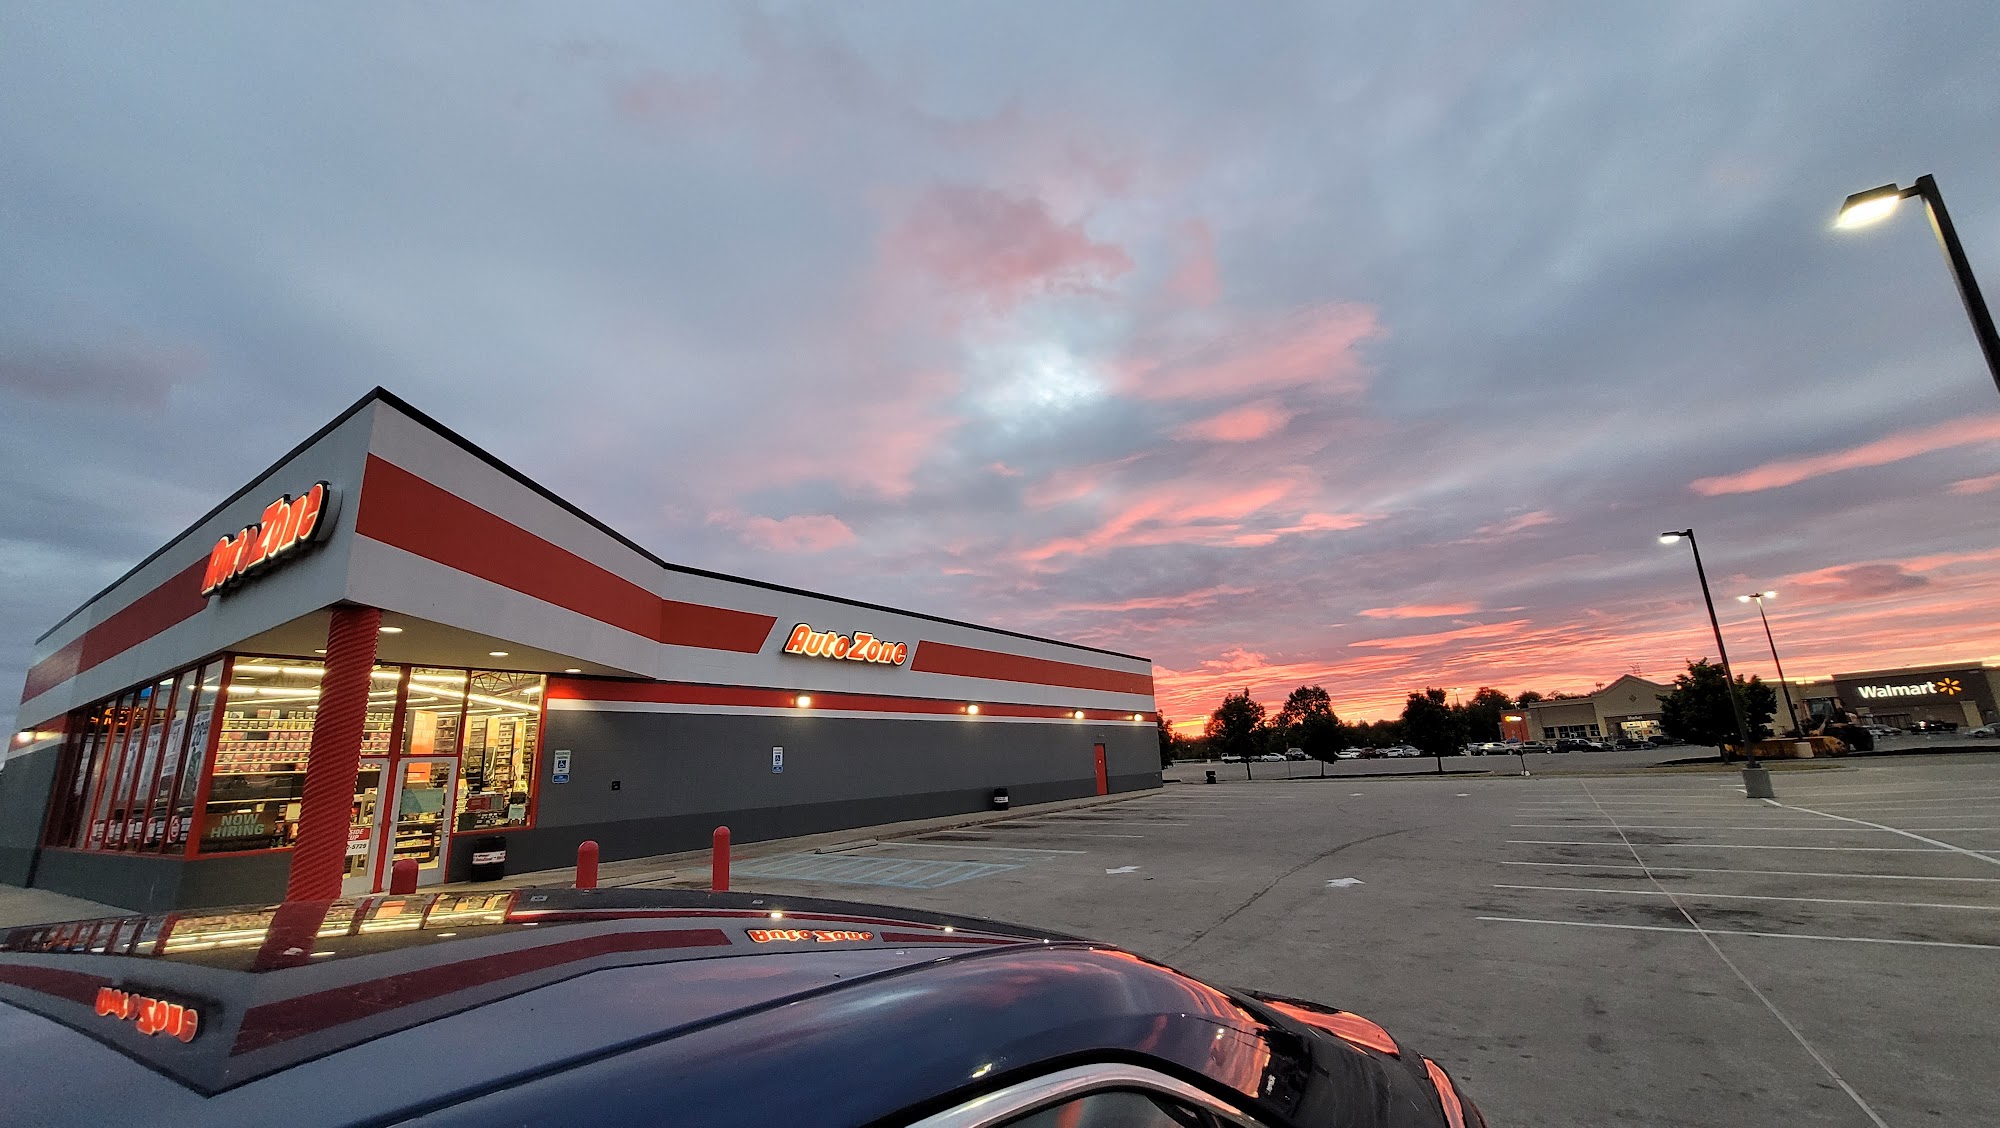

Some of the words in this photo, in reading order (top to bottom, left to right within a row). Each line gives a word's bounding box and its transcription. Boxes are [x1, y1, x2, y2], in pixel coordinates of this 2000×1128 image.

[784, 623, 908, 666] AutoZone
[1857, 681, 1938, 699] Walmart
[221, 813, 260, 826] NOW
[210, 823, 265, 838] HIRING
